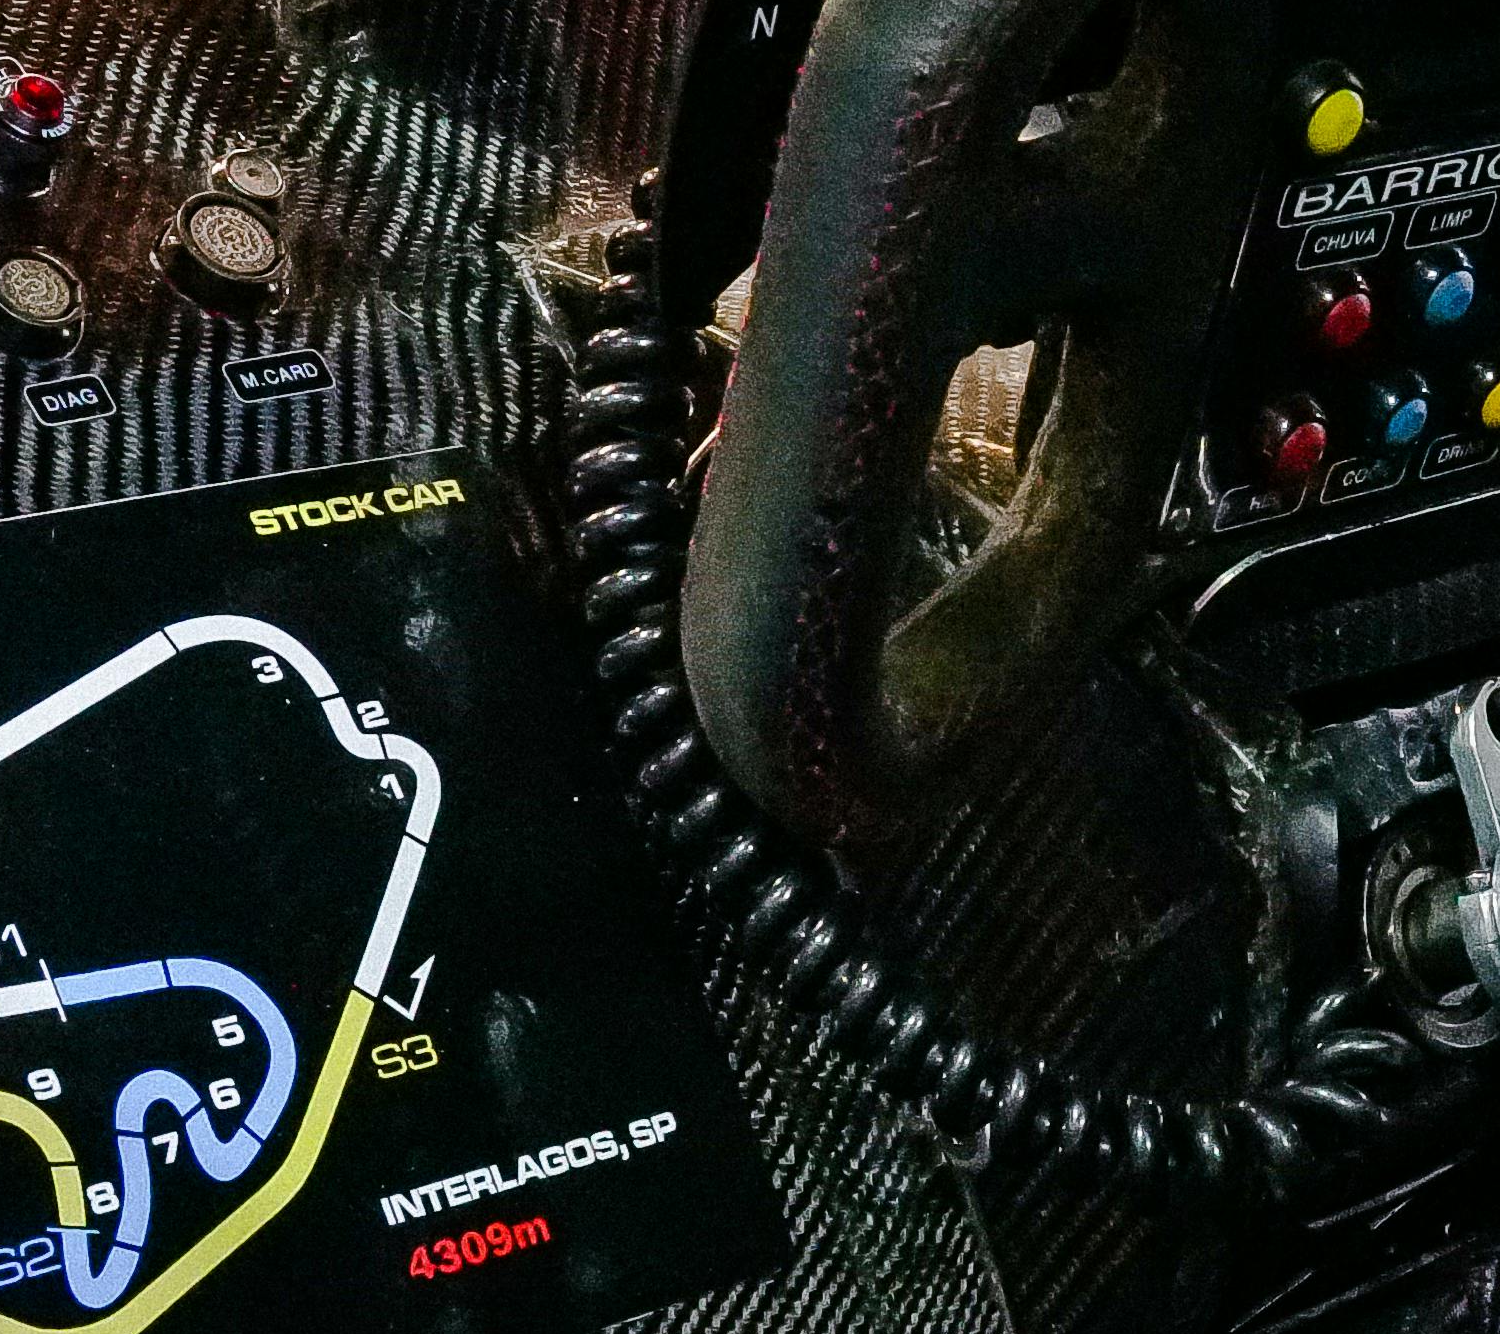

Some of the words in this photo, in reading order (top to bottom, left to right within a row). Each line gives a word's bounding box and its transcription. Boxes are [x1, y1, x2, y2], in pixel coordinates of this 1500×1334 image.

[1430, 208, 1474, 232] LIMP
[1314, 227, 1376, 253] CHUVA
[240, 363, 317, 388] M.CARD
[42, 389, 98, 411] DIAG
[248, 492, 373, 536] STOCK
[383, 479, 465, 514] CAR
[252, 656, 283, 683] 3
[357, 701, 389, 728] 2
[380, 774, 404, 799] 1
[212, 1015, 245, 1046] 5
[372, 1035, 438, 1078] S3
[27, 1068, 61, 1100] 9
[209, 1078, 241, 1109] 6
[152, 1131, 178, 1164] 7
[380, 1131, 629, 1225] INTERLAGOS,
[629, 1112, 676, 1148] SP
[86, 1182, 120, 1214] 8
[410, 1217, 550, 1279] 4309m
